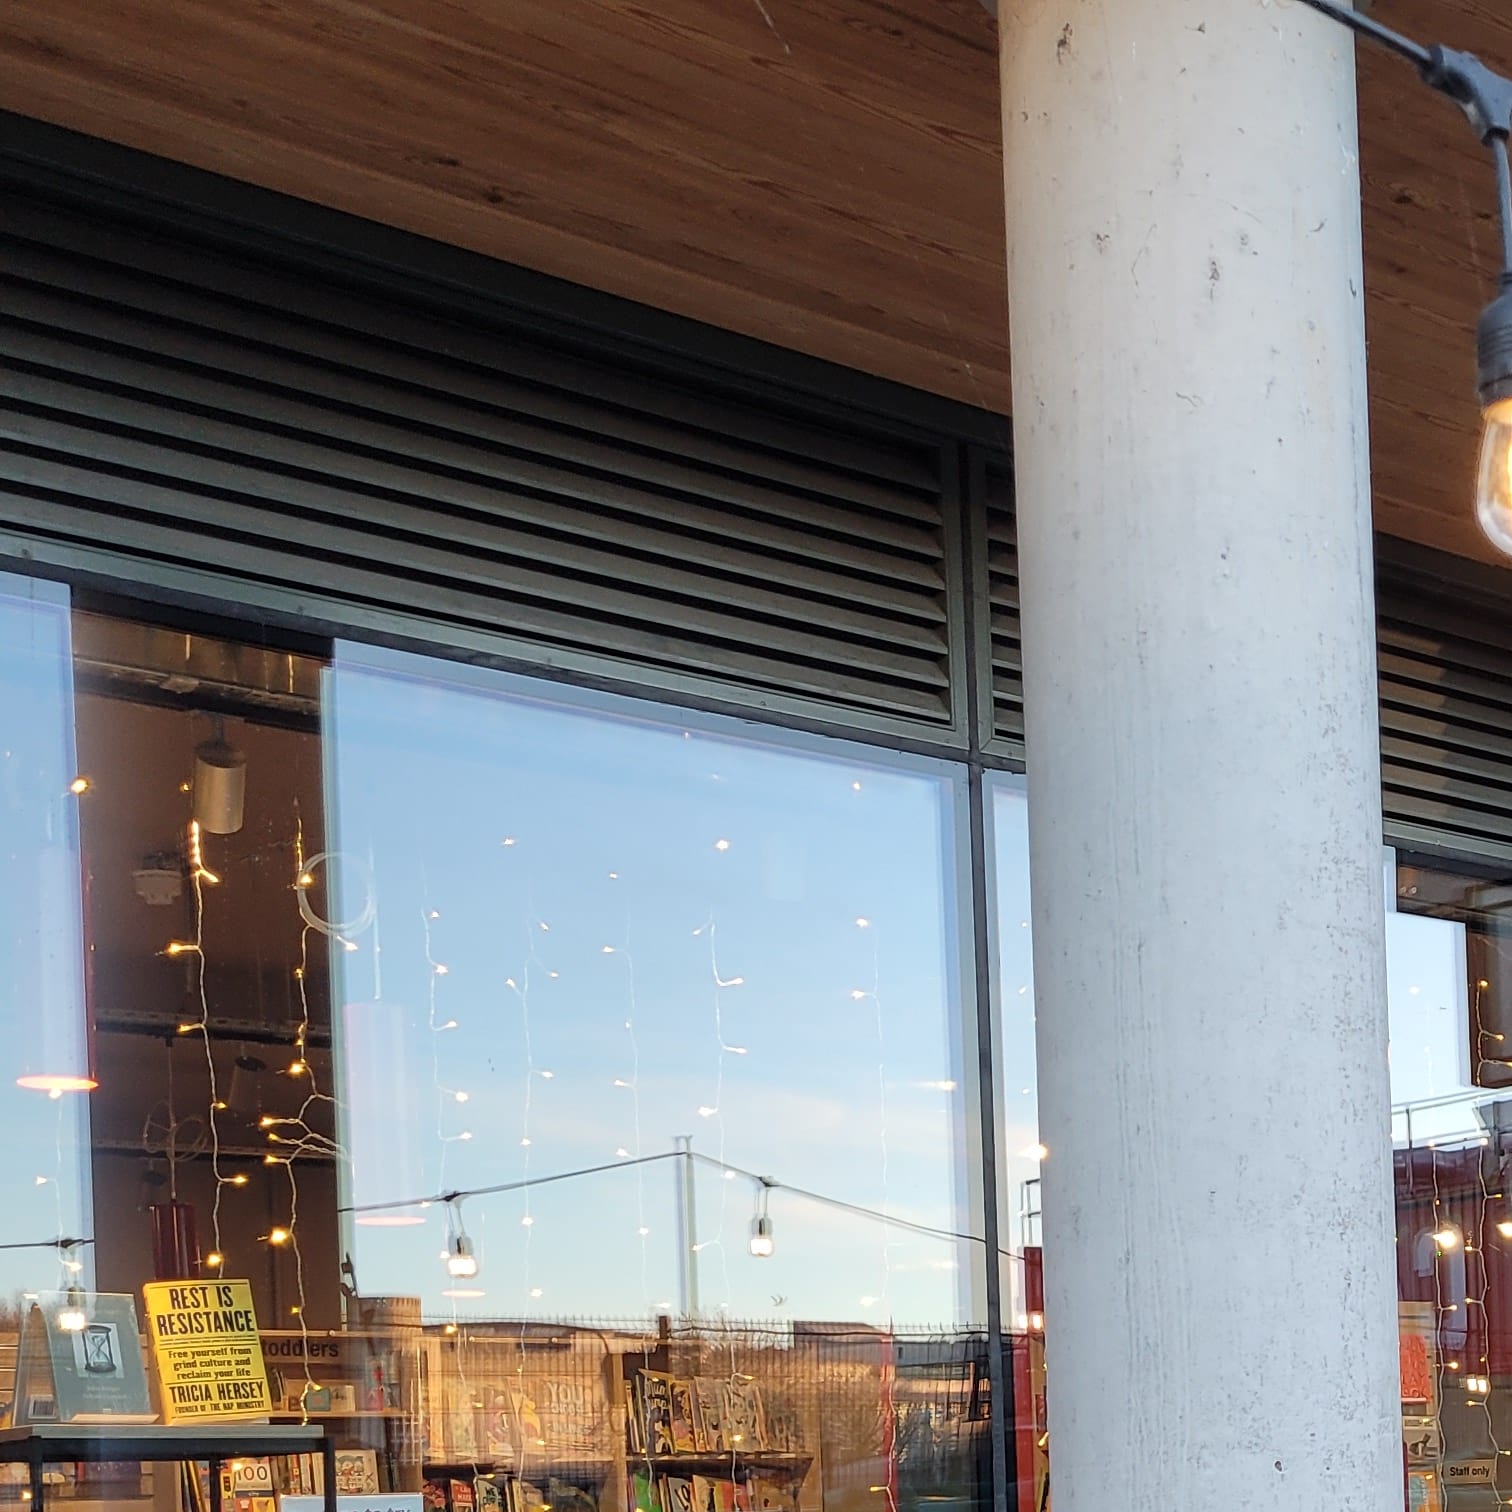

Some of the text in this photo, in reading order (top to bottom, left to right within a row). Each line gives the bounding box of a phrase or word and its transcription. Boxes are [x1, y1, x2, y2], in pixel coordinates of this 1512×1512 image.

[169, 1286, 234, 1310] REST IS
[156, 1310, 255, 1336] RESISTANCE
[168, 1347, 252, 1359] Free yourself from
[263, 1336, 339, 1357] toddlers
[173, 1358, 251, 1372] grind culture and
[176, 1367, 251, 1381] reclaim your life
[169, 1380, 264, 1404] TRICIA HERSEY
[175, 1400, 265, 1414] FOUNDER OF THE NAP MINISTRY
[1449, 1466, 1490, 1478] Staff only
